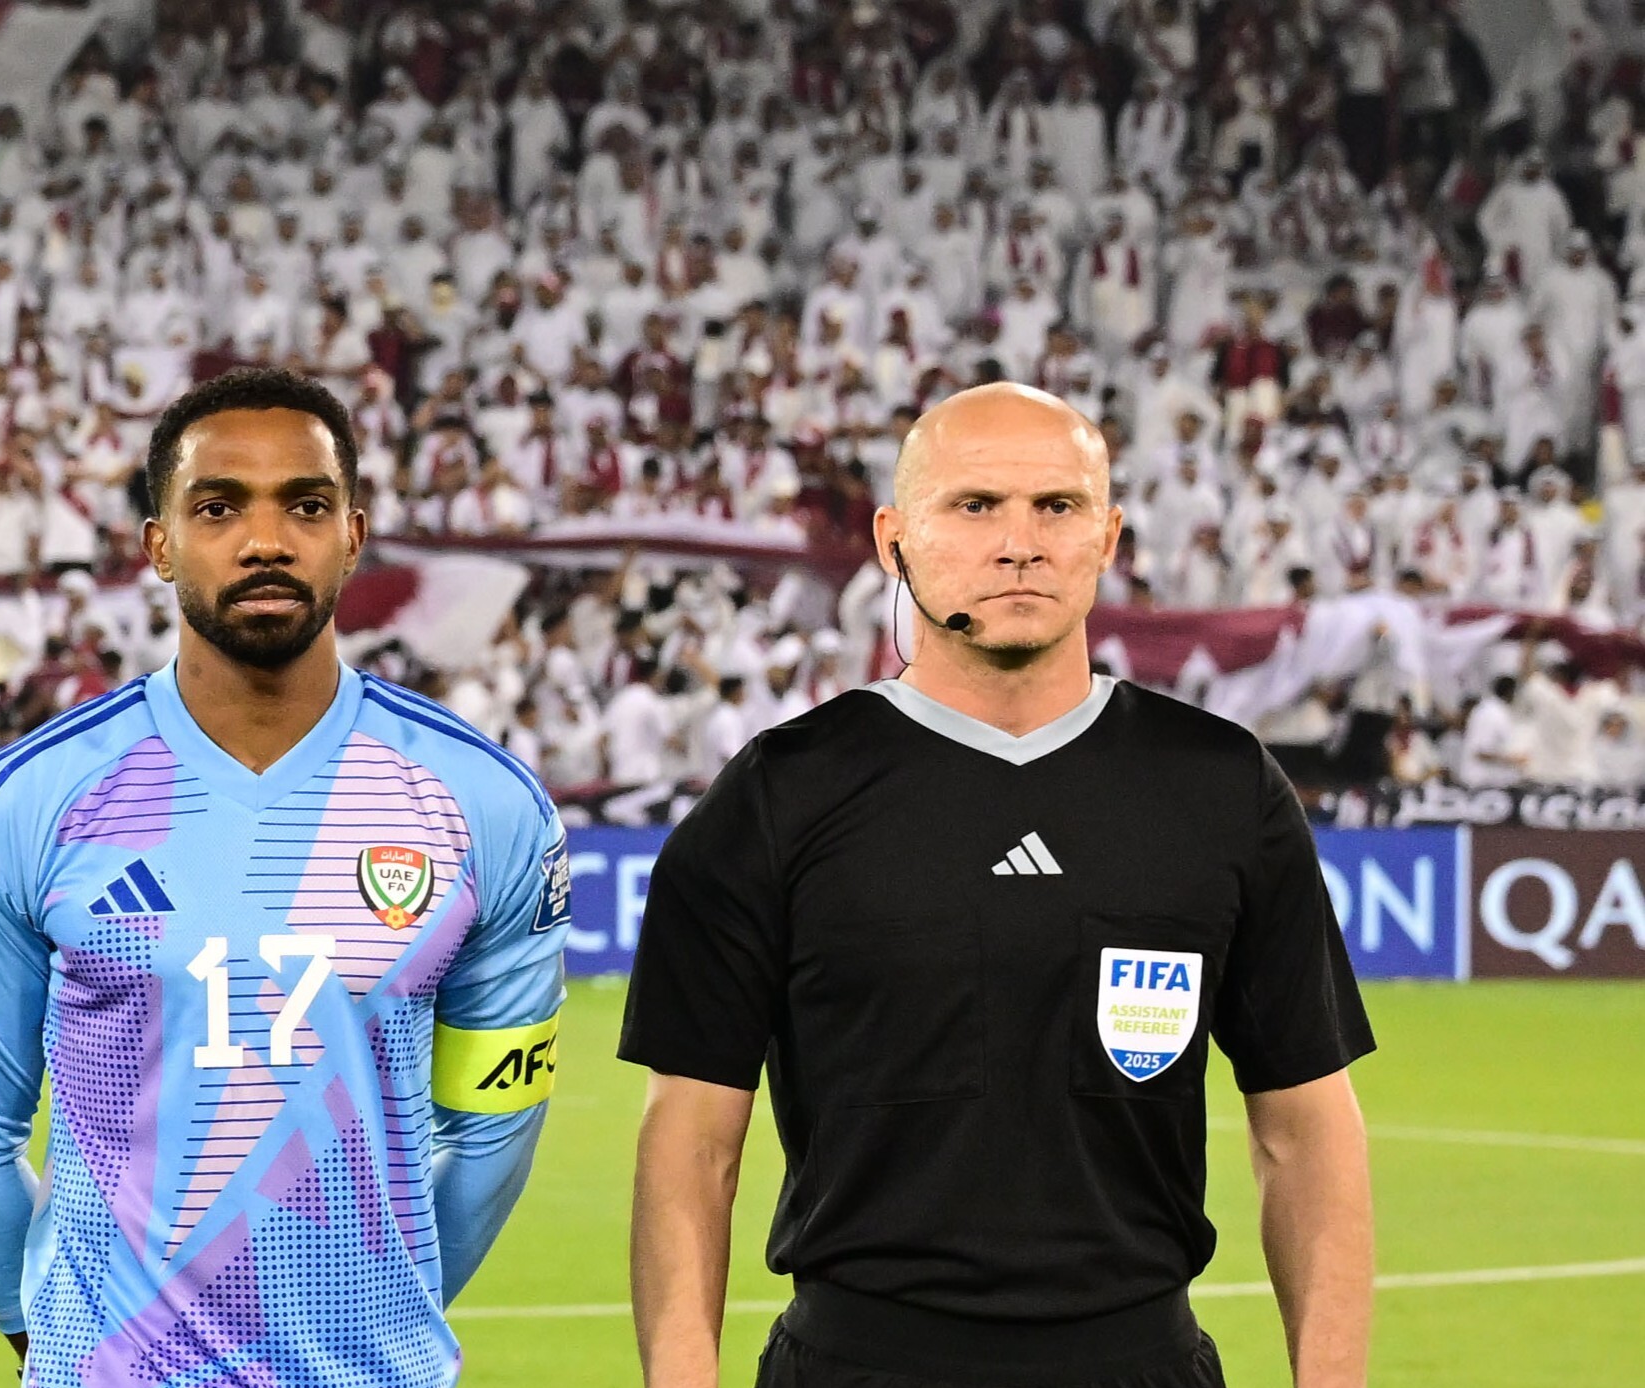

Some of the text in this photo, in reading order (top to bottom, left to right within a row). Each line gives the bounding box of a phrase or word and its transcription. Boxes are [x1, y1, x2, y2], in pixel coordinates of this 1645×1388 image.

[379, 868, 414, 882] UAE
[388, 882, 407, 893] FA
[1478, 857, 1645, 970] QA
[1110, 959, 1191, 992] FIFA
[186, 934, 336, 1068] 17
[1108, 1003, 1189, 1020] ASSISTANT
[1113, 1019, 1180, 1036] REFEREE
[1122, 1053, 1161, 1069] 2025
